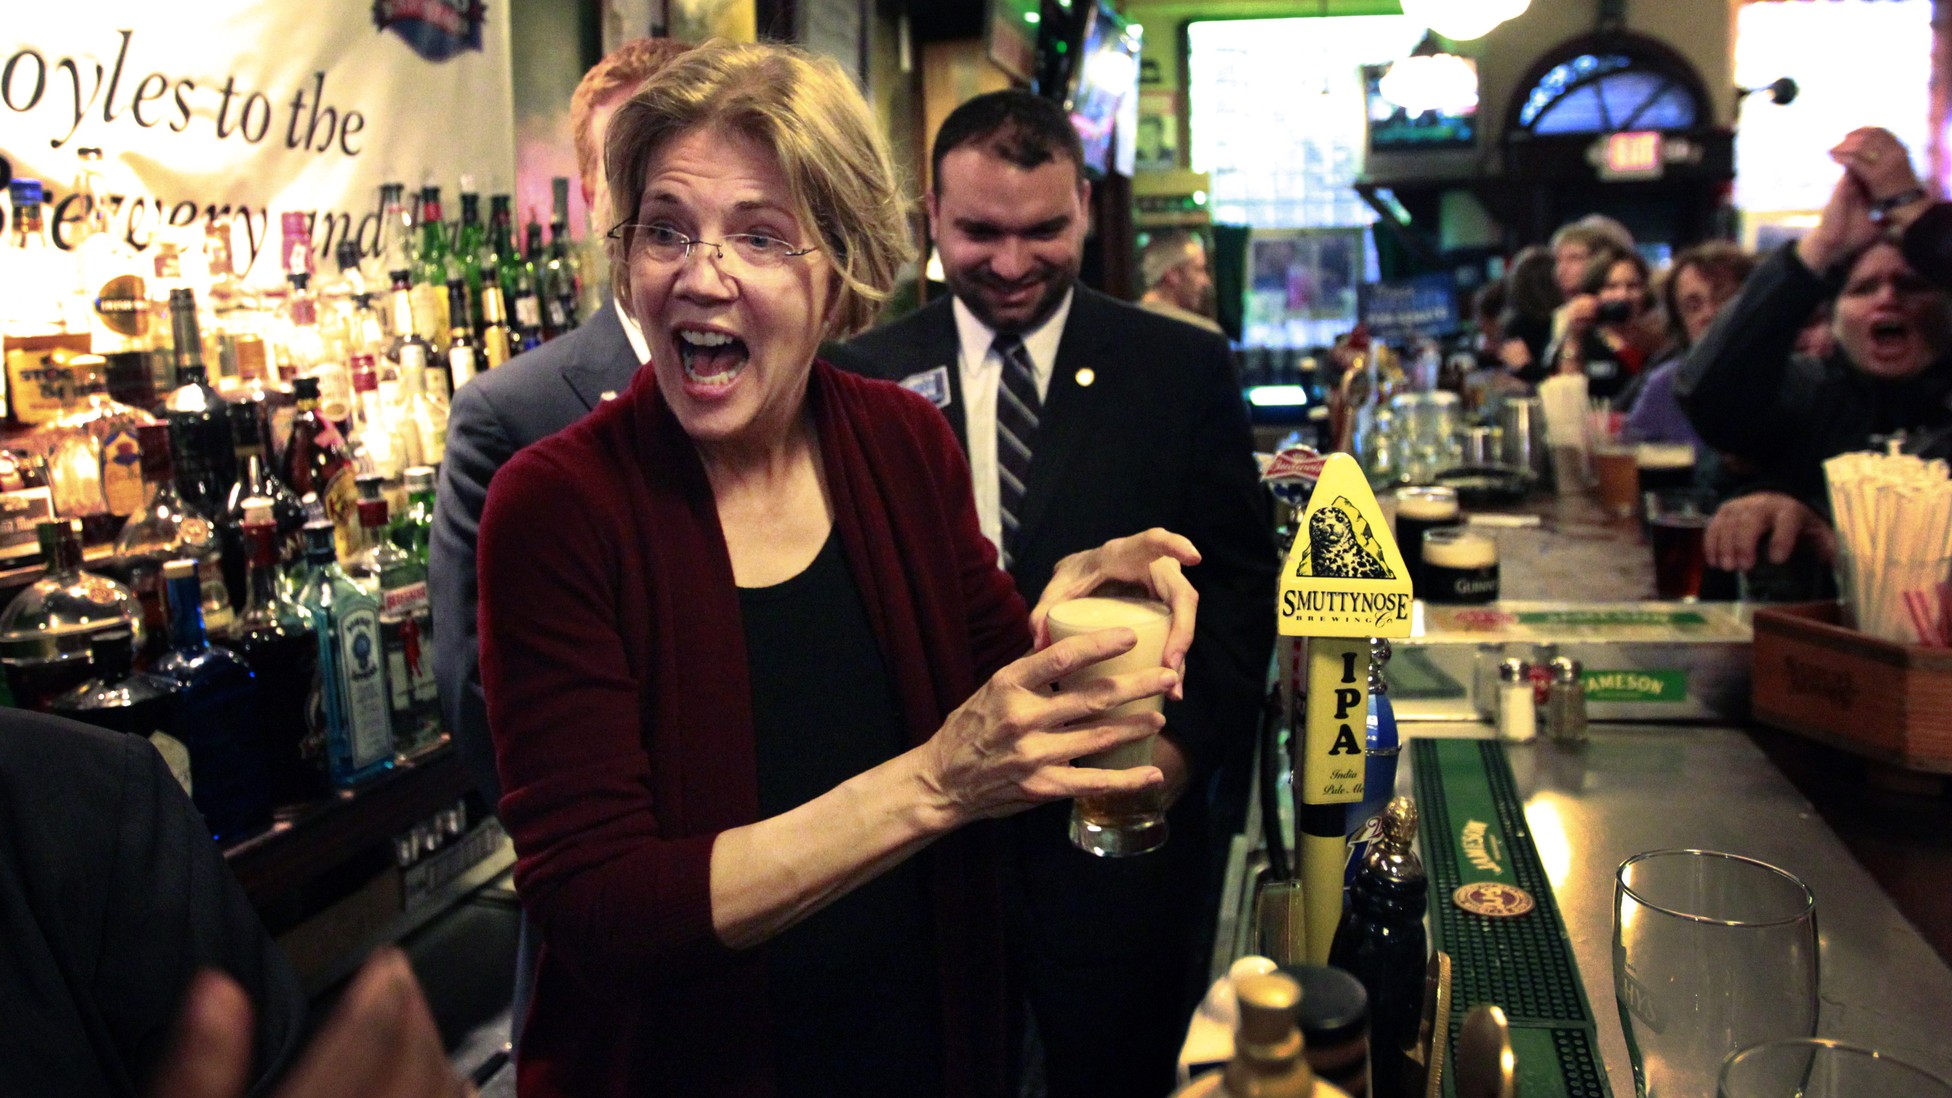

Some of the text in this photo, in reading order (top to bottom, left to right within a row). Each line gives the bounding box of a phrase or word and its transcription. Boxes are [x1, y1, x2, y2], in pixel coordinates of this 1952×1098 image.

[1, 30, 364, 156] oyles to the
[1282, 589, 1409, 620] SMUTTYNOSE
[1296, 615, 1372, 623] BREWING
[1328, 652, 1362, 756] IPA
[1330, 769, 1357, 780] India
[1322, 783, 1364, 796] Pale Ale
